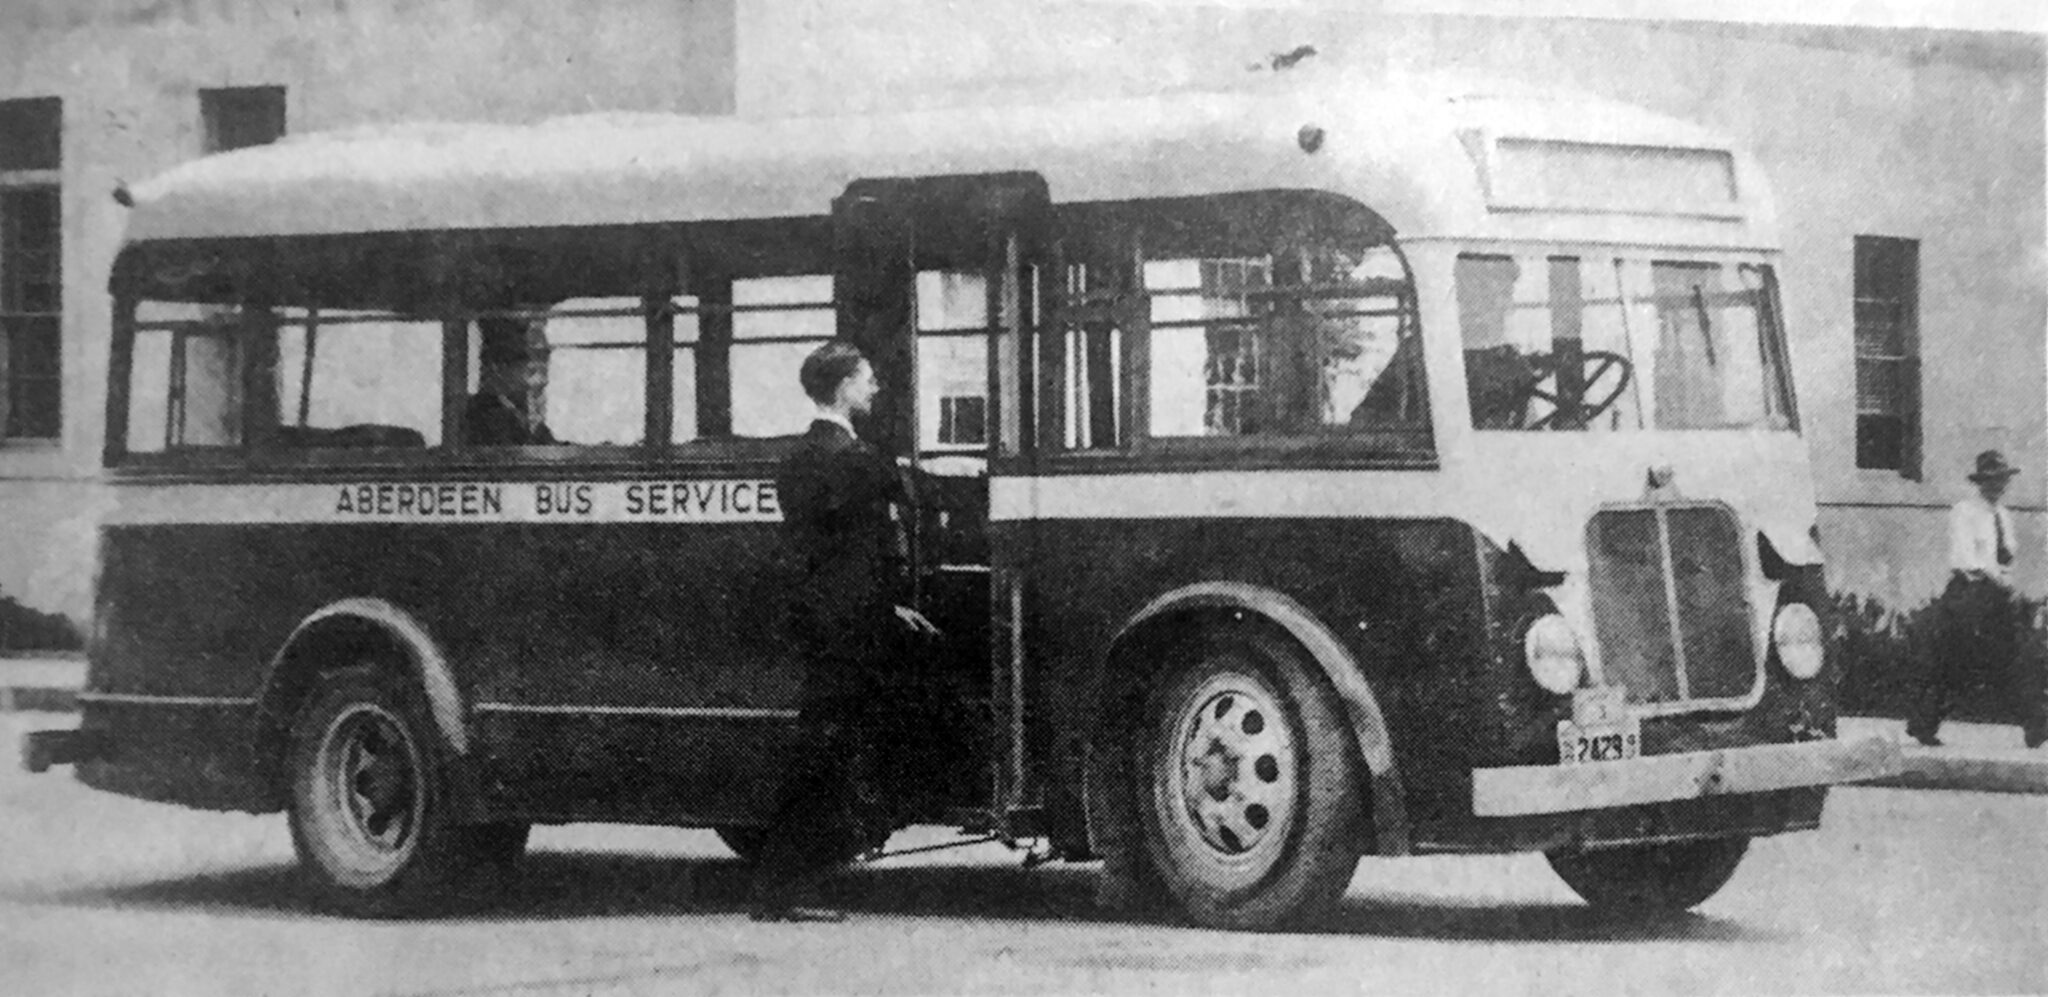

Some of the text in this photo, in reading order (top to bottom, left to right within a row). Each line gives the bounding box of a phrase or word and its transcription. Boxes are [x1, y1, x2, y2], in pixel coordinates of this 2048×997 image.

[336, 482, 777, 515] ABERDEEN BUS SERVICE
